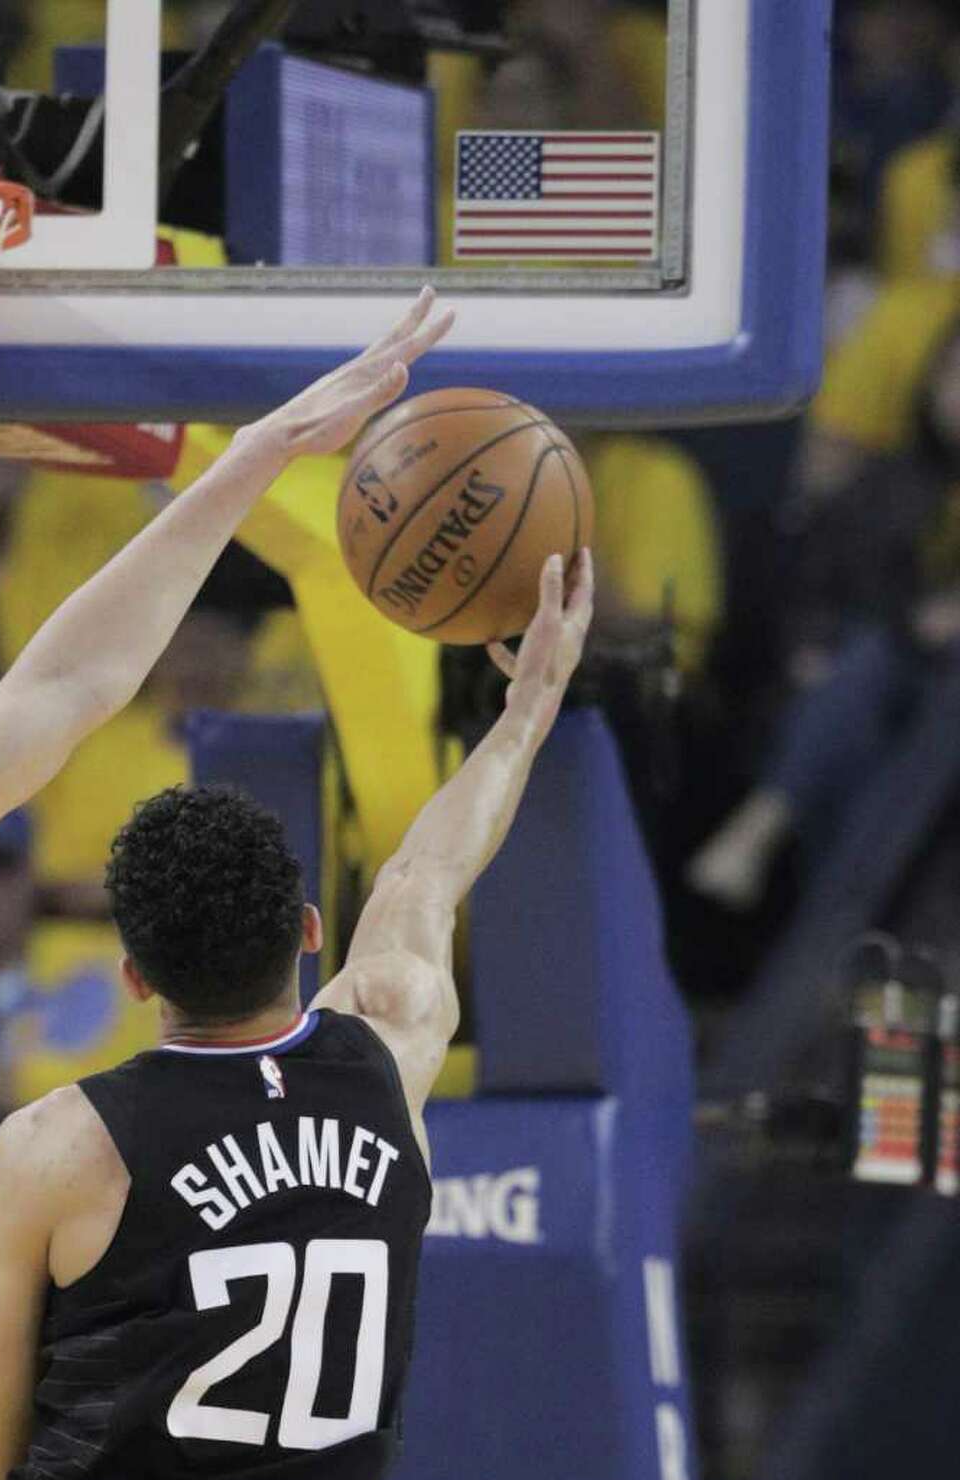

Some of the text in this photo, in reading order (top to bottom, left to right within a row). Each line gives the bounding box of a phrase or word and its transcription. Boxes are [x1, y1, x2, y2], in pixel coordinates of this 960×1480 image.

[378, 468, 505, 617] SPALDING
[170, 1115, 400, 1231] SHAMET
[166, 1239, 388, 1451] 20
